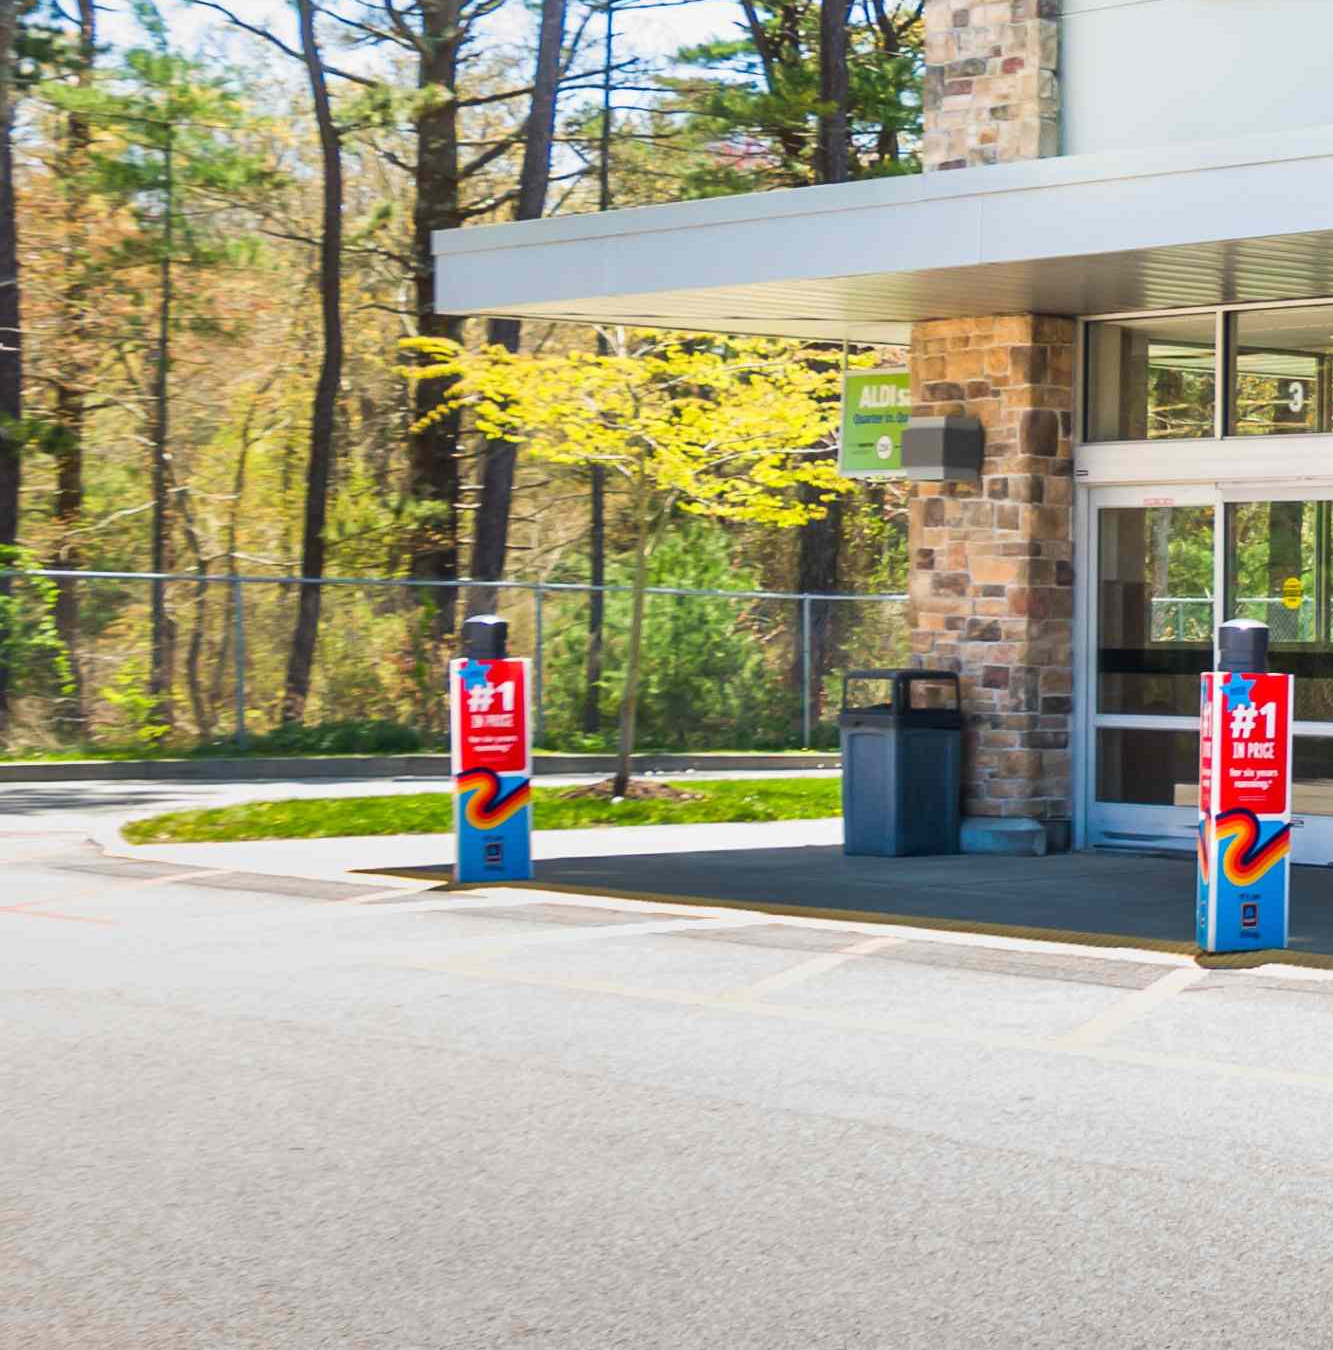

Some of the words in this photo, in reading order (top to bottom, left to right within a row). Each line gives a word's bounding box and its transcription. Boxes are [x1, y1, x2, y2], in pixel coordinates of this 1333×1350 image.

[860, 384, 897, 409] ALDI
[1289, 381, 1303, 413] 3
[467, 681, 515, 712] #1
[1230, 701, 1277, 739] #1
[1247, 741, 1276, 759] PRICE
